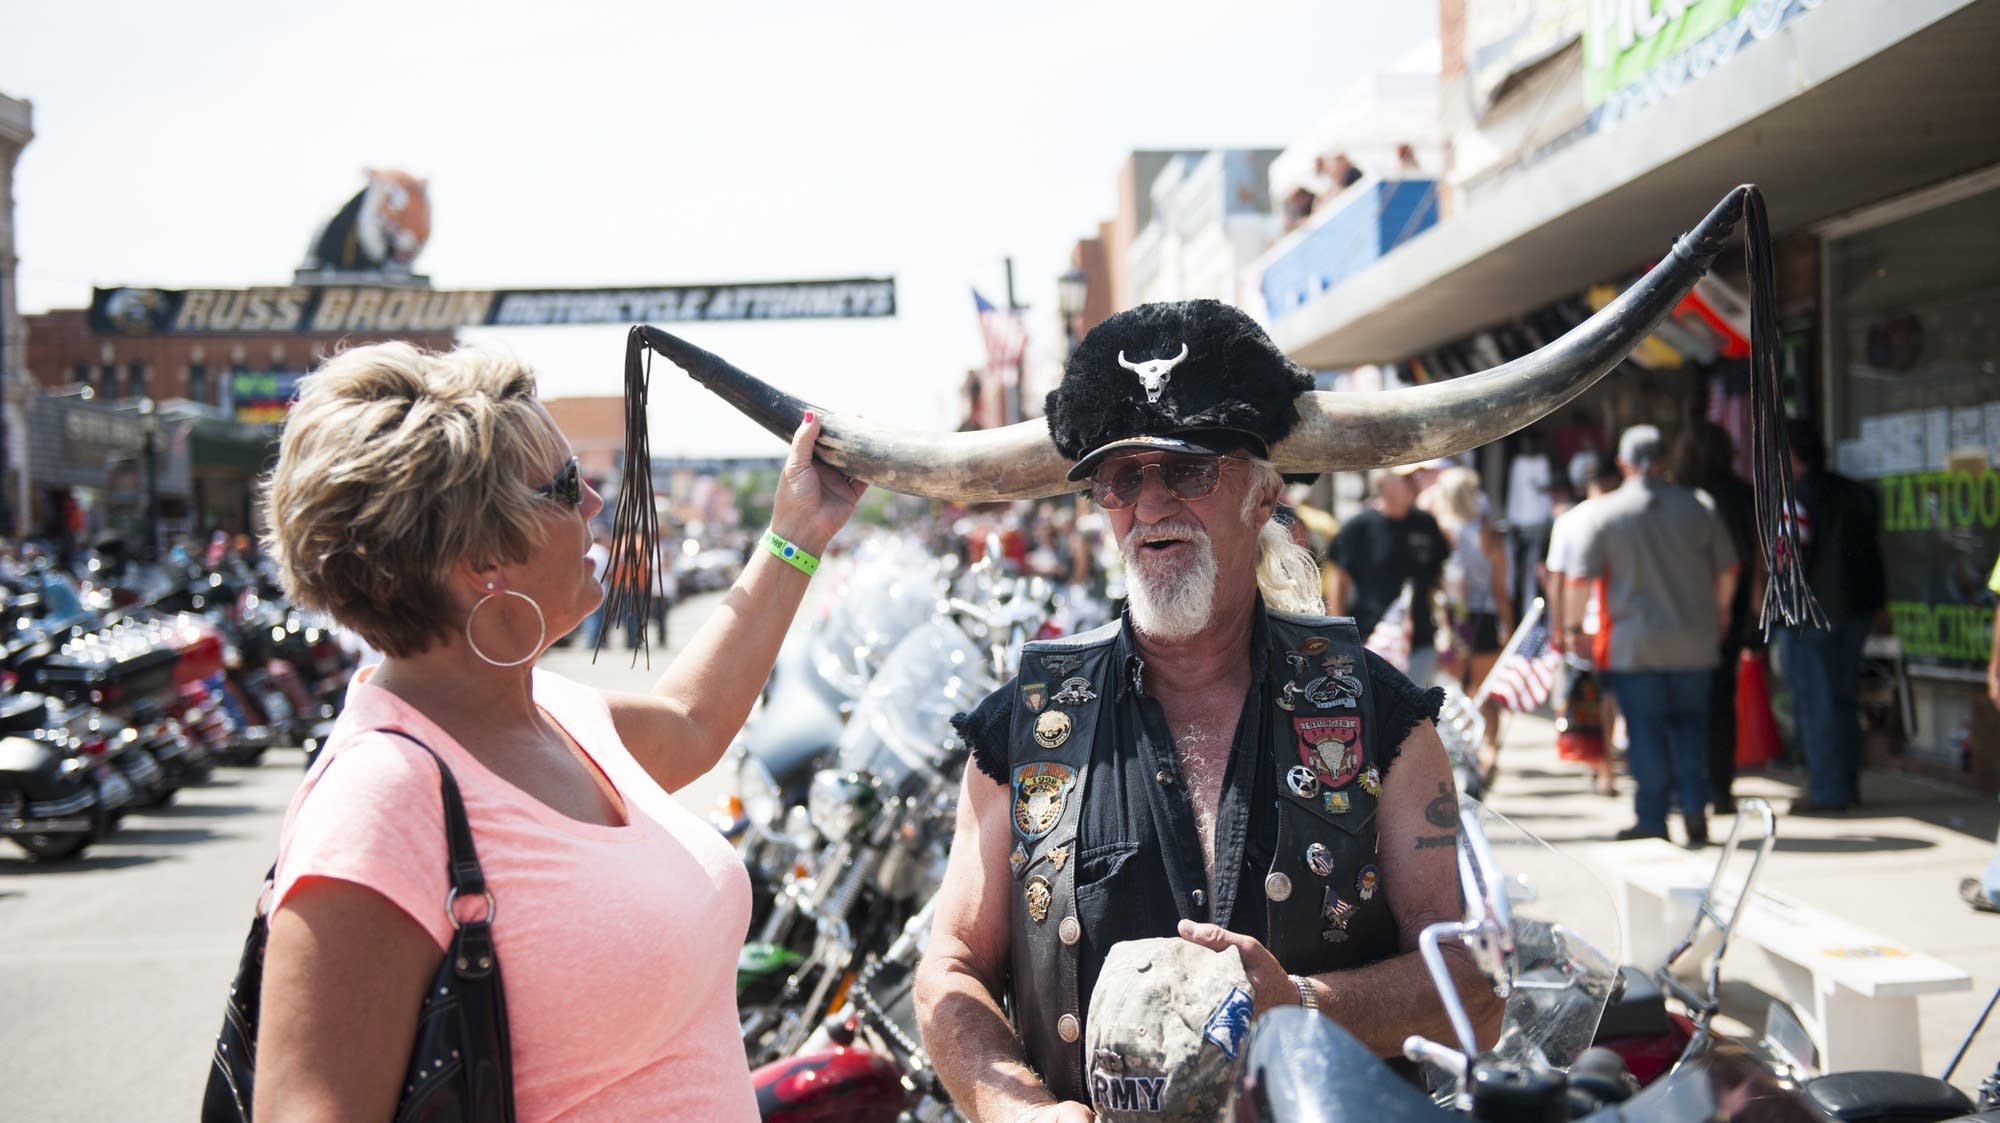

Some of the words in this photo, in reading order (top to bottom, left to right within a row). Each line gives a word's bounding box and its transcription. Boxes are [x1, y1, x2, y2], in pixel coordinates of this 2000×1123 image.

[175, 289, 308, 331] RUSS
[311, 288, 493, 331] BROWN
[498, 287, 711, 324] MOTORCYCLE
[703, 283, 893, 319] ATTORNEYS
[1308, 720, 1347, 728] STURGIS
[1032, 776, 1058, 784] 1998
